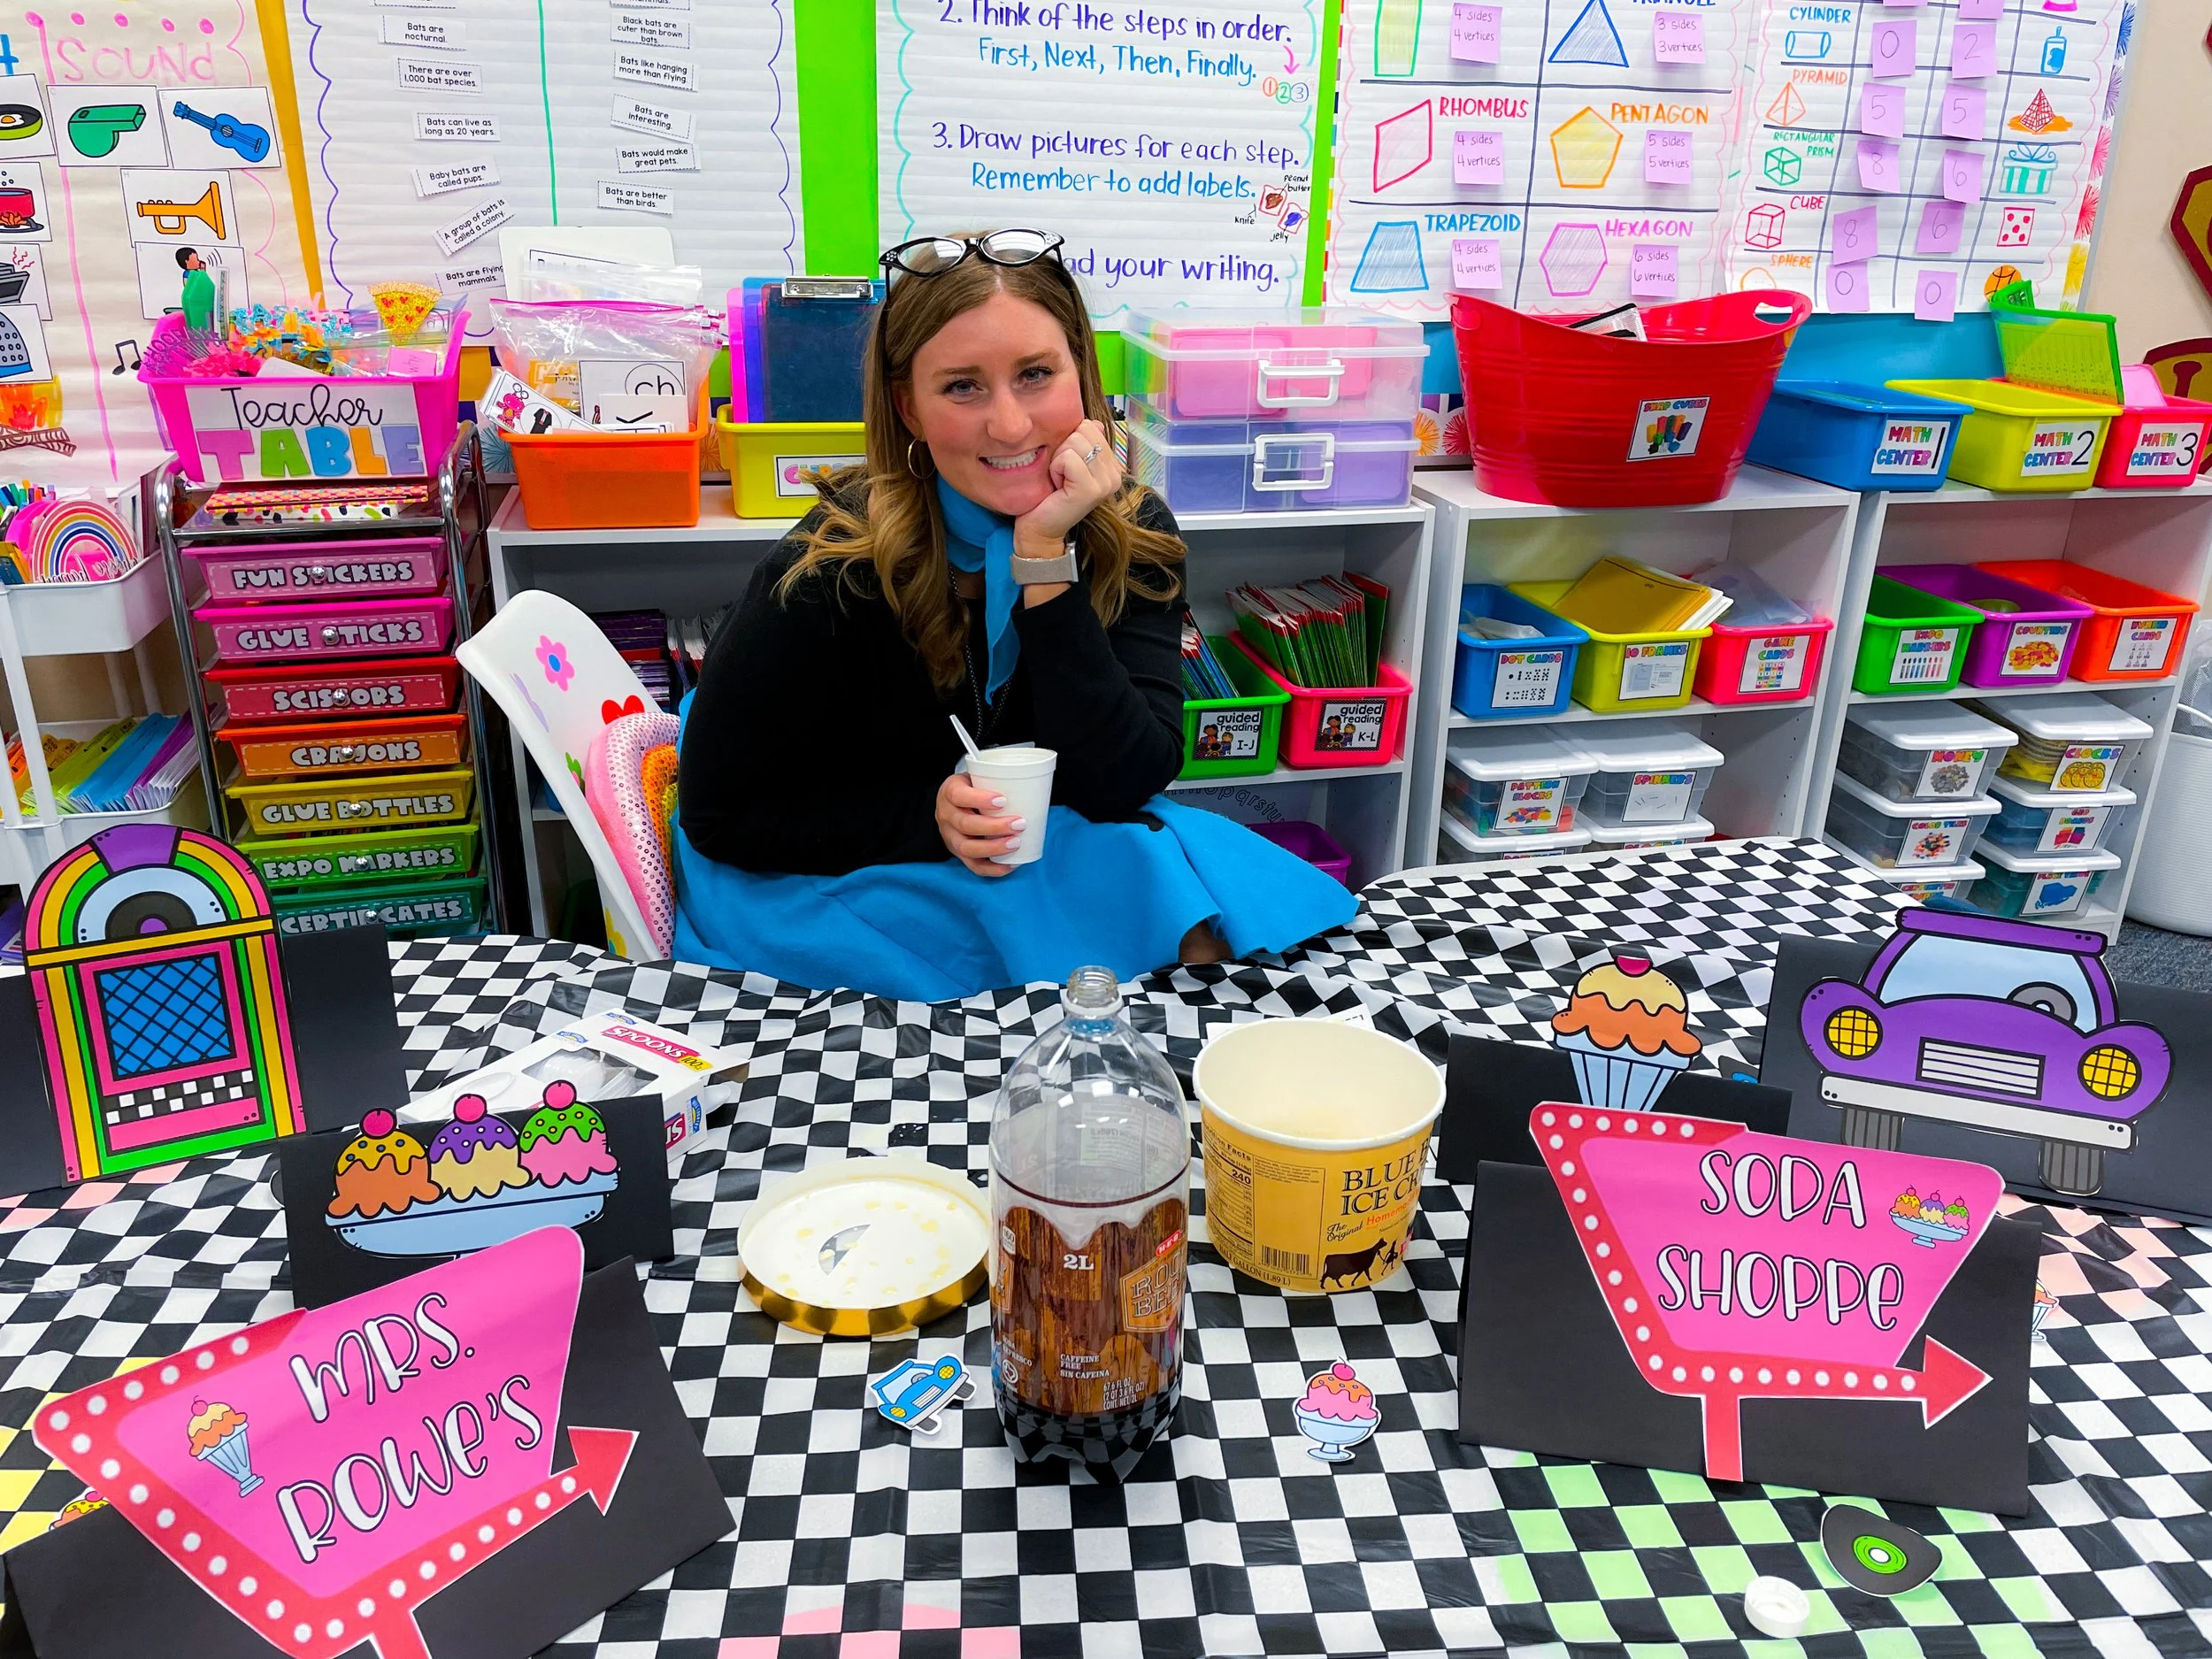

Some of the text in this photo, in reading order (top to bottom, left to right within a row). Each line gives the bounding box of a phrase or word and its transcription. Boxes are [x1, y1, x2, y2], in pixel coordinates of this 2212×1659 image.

[623, 16, 643, 25] Black
[940, 0, 1292, 45] 2. Think of the steps in order.
[1789, 7, 1851, 24] CYLINDER
[407, 23, 444, 34] Bats are
[1657, 18, 1697, 30] 3 sides
[404, 33, 448, 42] nocturnal.
[658, 29, 683, 38] brown
[1659, 41, 1702, 52] 3 vertices
[1962, 32, 1981, 61] 2
[979, 37, 1257, 87] First, Next, Then, Finally.
[408, 65, 432, 74] There
[435, 67, 450, 76] are
[1793, 68, 1847, 84] PYRAMID
[404, 74, 478, 87] 1,000 bat species.
[1439, 96, 1530, 119] RHOMBUS
[1611, 103, 1709, 125] PENTAGON
[1871, 94, 1888, 120] 5
[1952, 97, 1968, 124] 5
[425, 127, 442, 136] long
[469, 127, 495, 136] years.
[1773, 131, 1835, 144] RECTANGULAR
[931, 122, 1300, 170] 3. Draw pictures for each step.
[1649, 134, 1686, 147] 5 sides
[1807, 145, 1835, 157] PRISM
[634, 157, 678, 167] great pets.
[1649, 156, 1690, 169] 5 vertices
[1871, 152, 1884, 175] 8
[972, 163, 1256, 197] Remember to add labels.
[1953, 159, 1968, 187] 6
[1789, 195, 1826, 210] CUBE
[1425, 213, 1521, 232] TRAPEZOID
[1605, 219, 1694, 237] HEXAGON
[1932, 211, 1948, 239] 6
[1270, 231, 1289, 244] jelly
[1844, 219, 1858, 248] 8
[1634, 250, 1670, 262] 6 sides
[1770, 253, 1814, 269] SPHERE
[1105, 255, 1173, 289] your
[1181, 254, 1279, 292] writing.
[1633, 269, 1676, 283] 6 vertices
[220, 383, 382, 430] Teacher
[1643, 399, 1708, 412] SNAP CUBES
[1888, 426, 1932, 442] MATH
[2034, 431, 2073, 447] MATH
[2141, 431, 2177, 447] MATH
[196, 423, 425, 480] TABLE
[1876, 427, 1946, 470] CENTER 1
[2024, 431, 2094, 467] CENTER 2
[2130, 432, 2199, 466] CENTER 3
[232, 561, 414, 589] FUN SICKERS
[236, 621, 424, 651] GLUE TICKS
[1764, 637, 1795, 648] GAME
[1501, 653, 1563, 664] DOT CARDS
[1625, 645, 1687, 658] 10 FRAMES
[1216, 711, 1260, 726] guided
[1340, 704, 1383, 718] guided
[1219, 722, 1260, 733] reading
[1343, 714, 1382, 725] reading
[1357, 731, 1377, 741] K-L
[1237, 740, 1256, 751] I-J
[1931, 750, 1985, 763] MONEY
[262, 802, 332, 824] GLUE
[262, 859, 333, 879] EXPO
[605, 1027, 687, 1058] SPOONS
[1232, 1169, 1251, 1185] 240
[1341, 1149, 1417, 1192] BLUE
[1700, 1149, 1868, 1229] SODA
[1341, 1187, 1389, 1216] ICE
[1327, 1223, 1348, 1233] The
[1327, 1220, 1363, 1242] Original
[1064, 1254, 1094, 1271] 2L
[1233, 1255, 1291, 1286] GALLON (1.89 L)
[1061, 1354, 1100, 1363] CAFFEINE
[1061, 1361, 1081, 1370] FREE
[1076, 1370, 1110, 1379] CAFEINA
